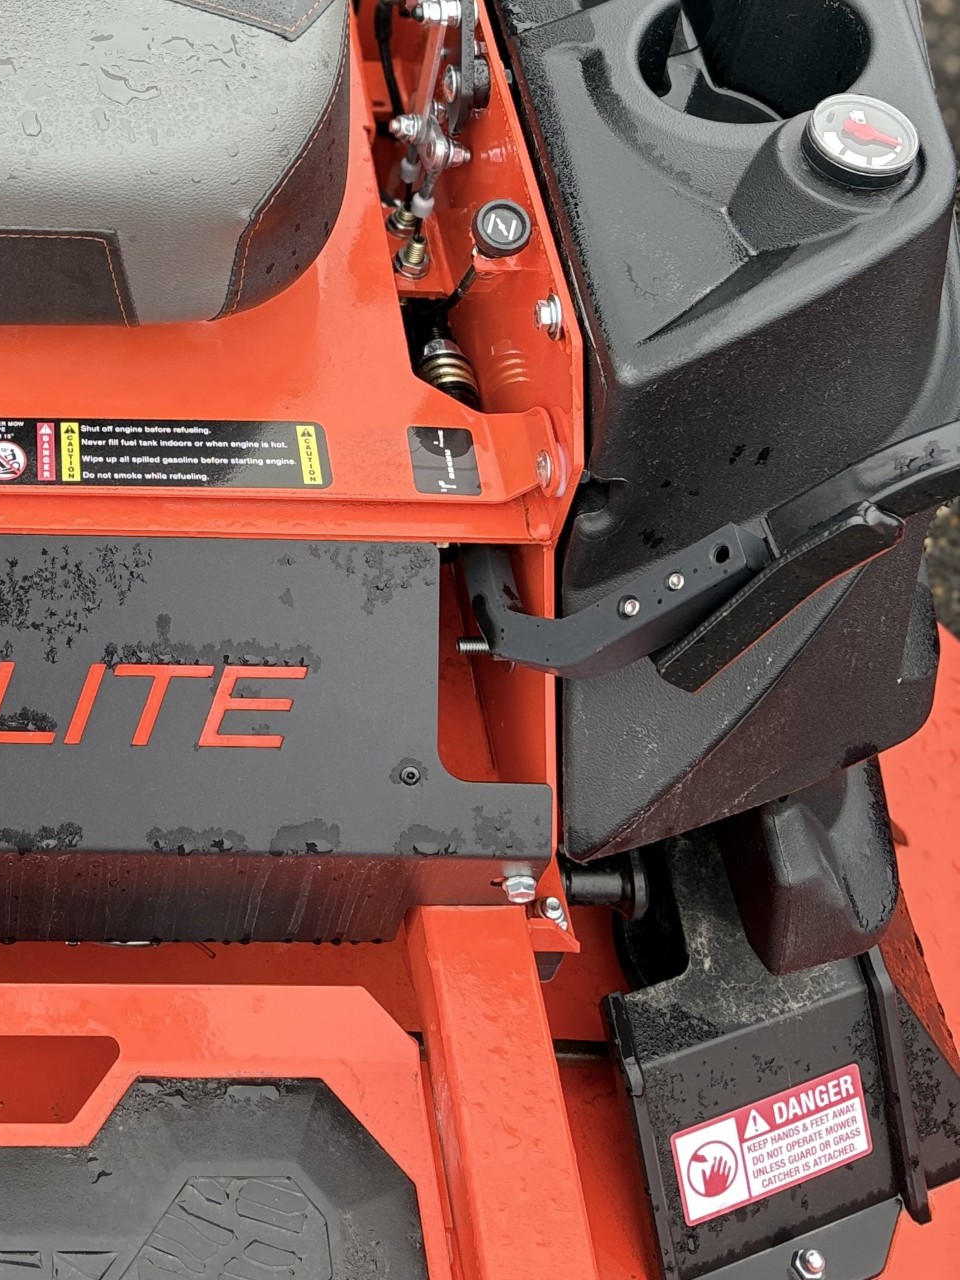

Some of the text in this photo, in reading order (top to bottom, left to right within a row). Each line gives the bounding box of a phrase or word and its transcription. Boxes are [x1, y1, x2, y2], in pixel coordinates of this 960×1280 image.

[42, 435, 50, 478] DANGER
[66, 435, 75, 479] CAUTION
[131, 456, 160, 464] spilled
[304, 438, 316, 482] CAUTION
[772, 1074, 855, 1125] DANGER
[747, 1102, 857, 1154] KEEP HANDS & FEET AWAY.
[752, 1115, 858, 1166] DO NOT OPERATE MOWER
[752, 1127, 861, 1179] UNLESS GUARD OR GRASS
[761, 1143, 858, 1189] CATCHER IS ATTACHED.
